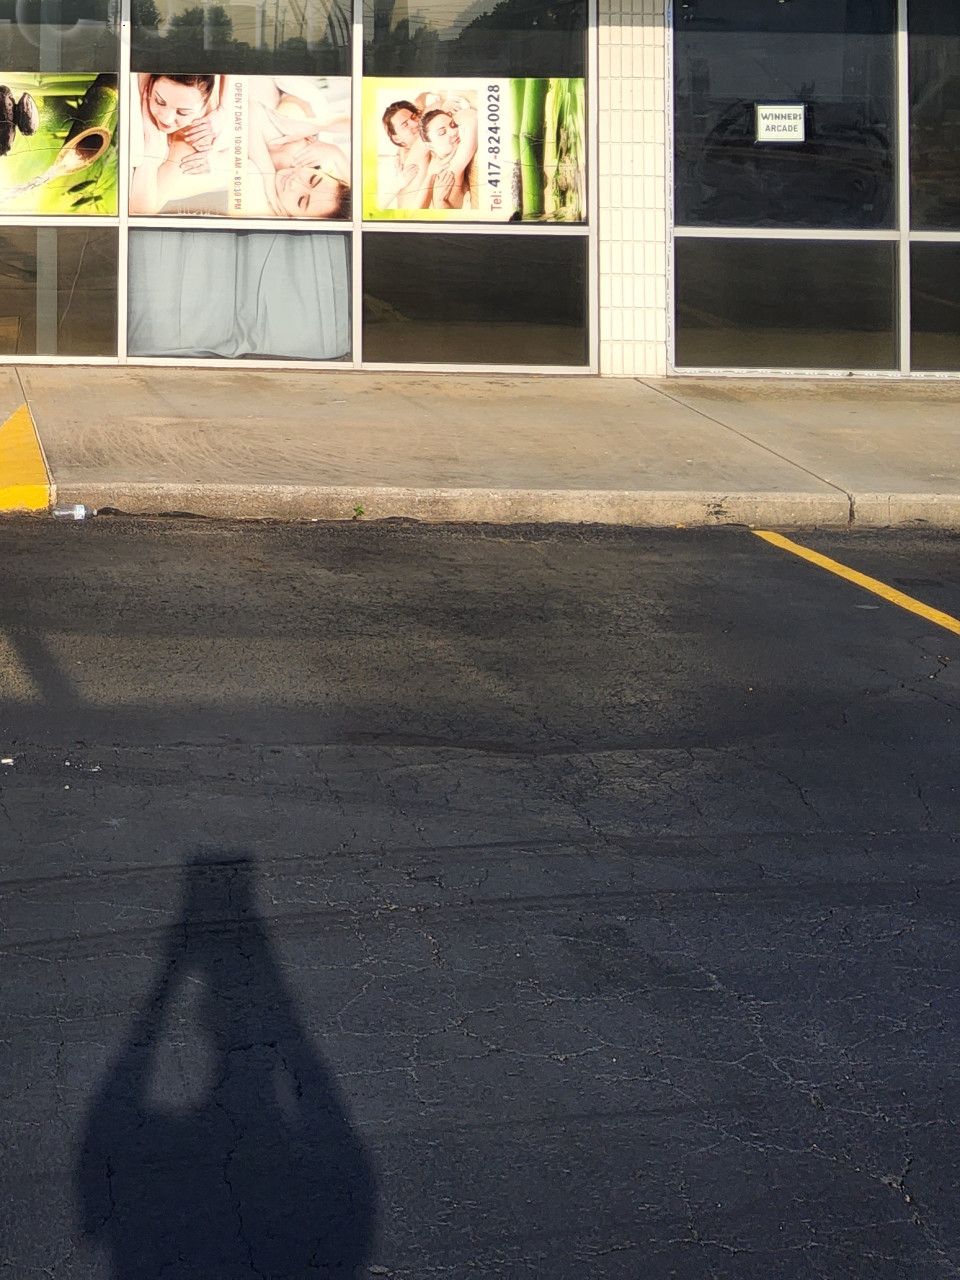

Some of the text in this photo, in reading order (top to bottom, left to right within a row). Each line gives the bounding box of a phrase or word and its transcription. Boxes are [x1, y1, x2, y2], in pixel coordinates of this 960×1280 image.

[234, 82, 243, 103] OPEN
[234, 111, 243, 131] DAYS
[765, 124, 799, 132] ARCADE
[234, 136, 242, 155] 10:00
[234, 157, 242, 168] AM
[234, 199, 242, 210] PM
[490, 191, 502, 212] Tel:
